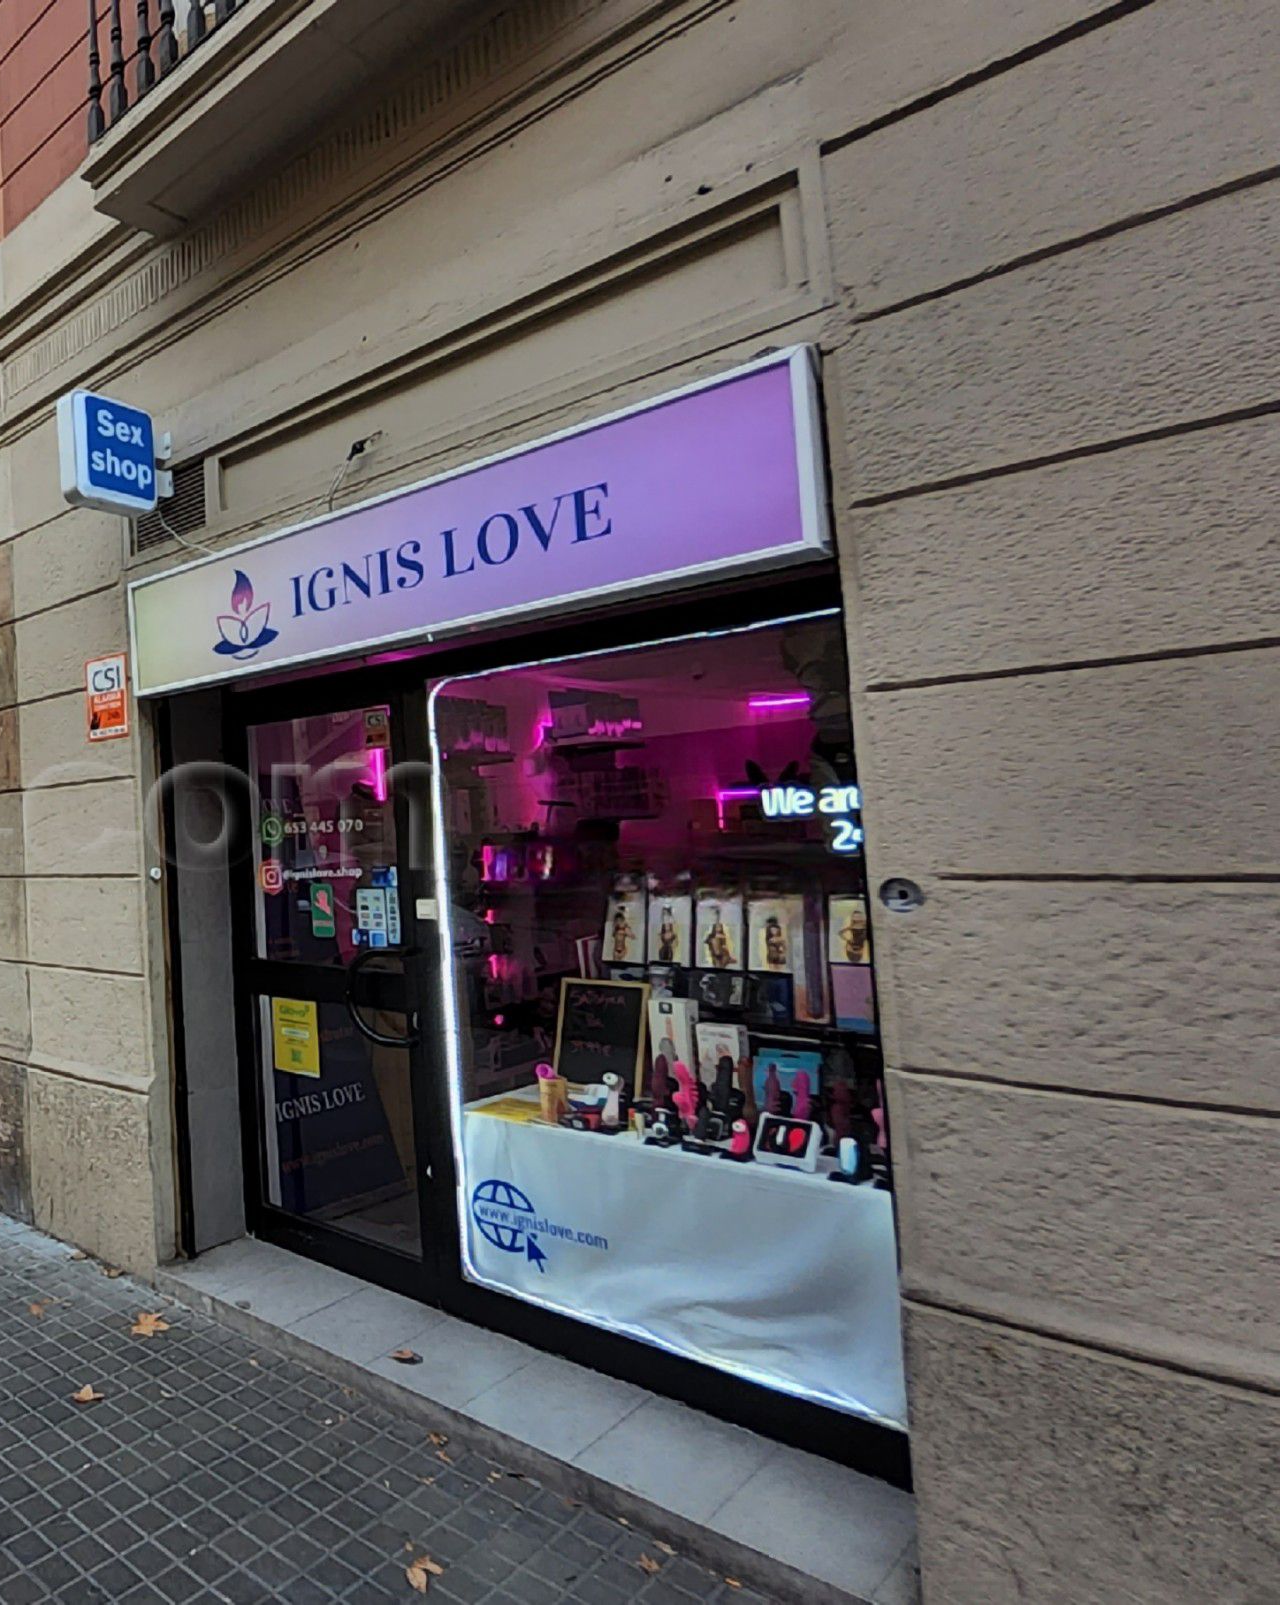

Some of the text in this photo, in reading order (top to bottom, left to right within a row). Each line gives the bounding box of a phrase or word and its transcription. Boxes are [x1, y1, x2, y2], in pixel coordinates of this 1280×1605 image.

[97, 409, 144, 447] Sex
[91, 448, 152, 489] shop
[289, 482, 612, 617] IGNIS LOVE
[92, 665, 120, 692] CSI
[761, 786, 814, 816] We
[284, 819, 363, 834] 653 445 070
[275, 1082, 366, 1123] IGNIS LOVE
[480, 1206, 608, 1250] www.ignislove.com
